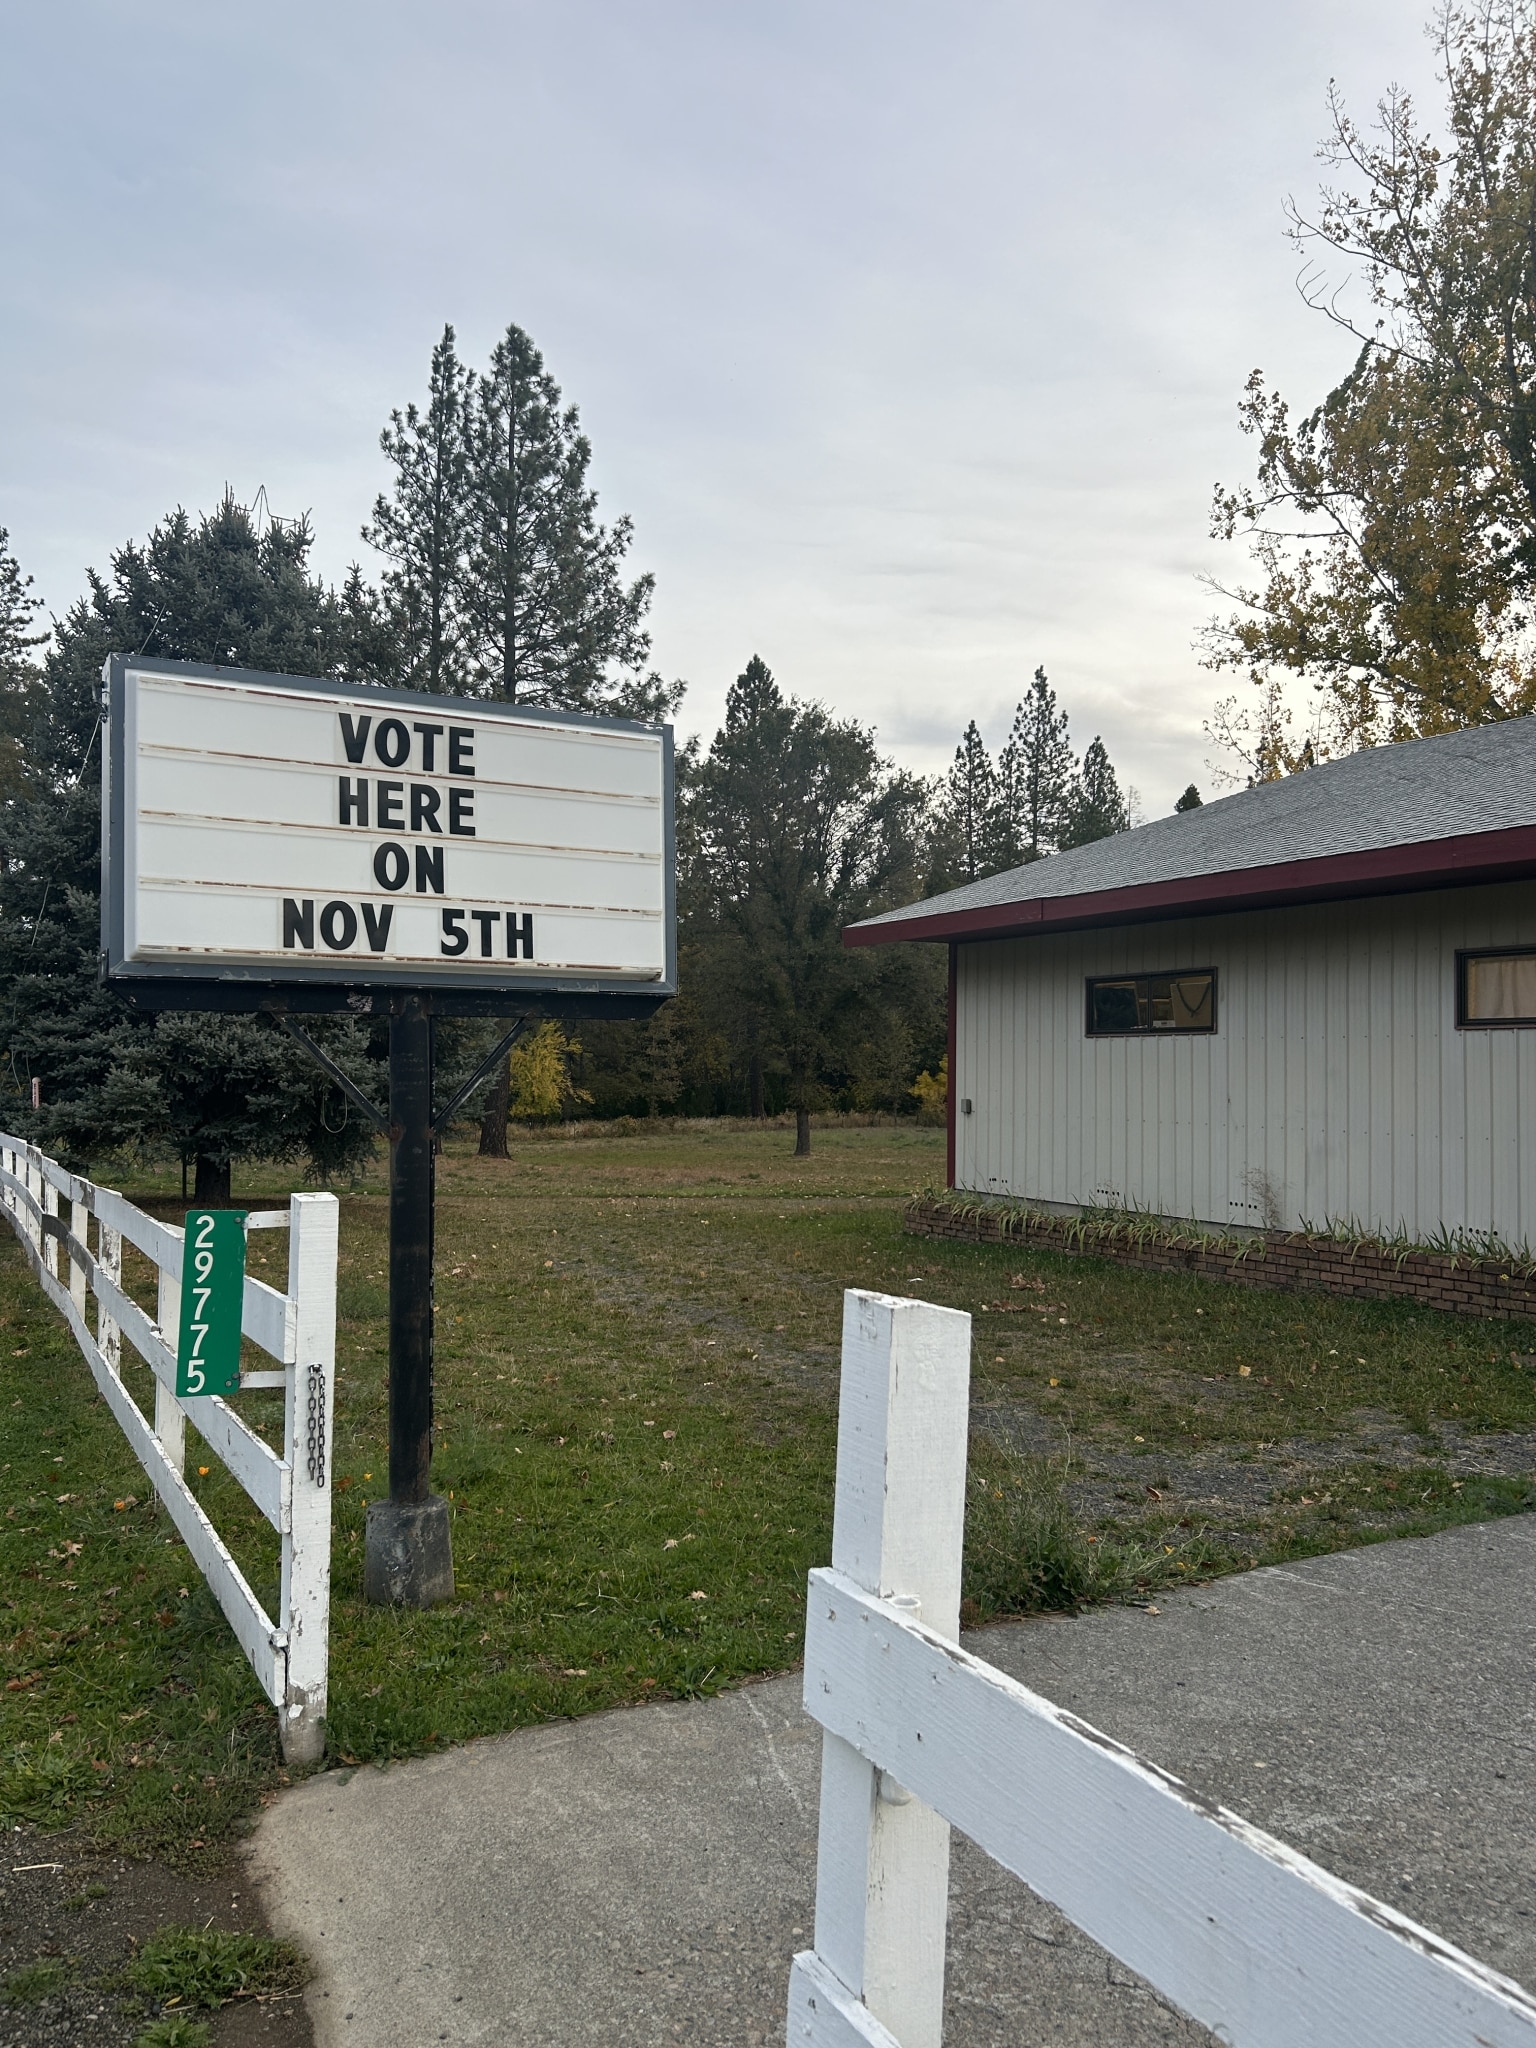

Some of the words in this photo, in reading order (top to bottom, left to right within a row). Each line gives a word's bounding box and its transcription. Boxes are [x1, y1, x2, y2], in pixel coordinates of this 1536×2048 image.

[338, 712, 476, 777] VOTE
[338, 775, 476, 836] HERE
[373, 841, 445, 895] ON
[282, 897, 395, 953] NOV
[440, 907, 534, 960] 5TH
[186, 1214, 216, 1394] 29775
